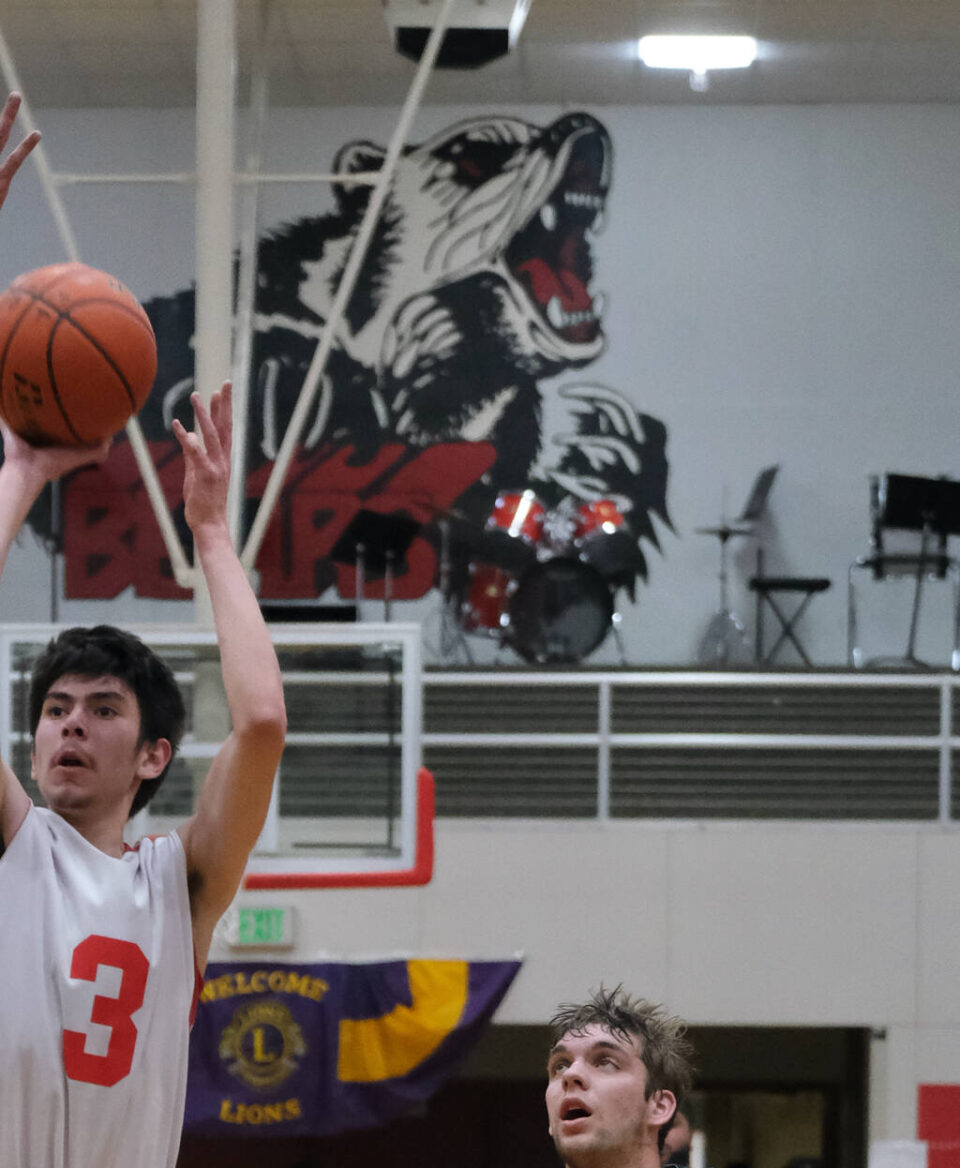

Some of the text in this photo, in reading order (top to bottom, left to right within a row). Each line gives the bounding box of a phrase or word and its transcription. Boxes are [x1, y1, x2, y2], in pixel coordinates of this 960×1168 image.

[64, 442, 496, 598] BERS
[239, 908, 285, 942] EXIT
[63, 934, 150, 1088] 3
[219, 1098, 301, 1125] LIONS
